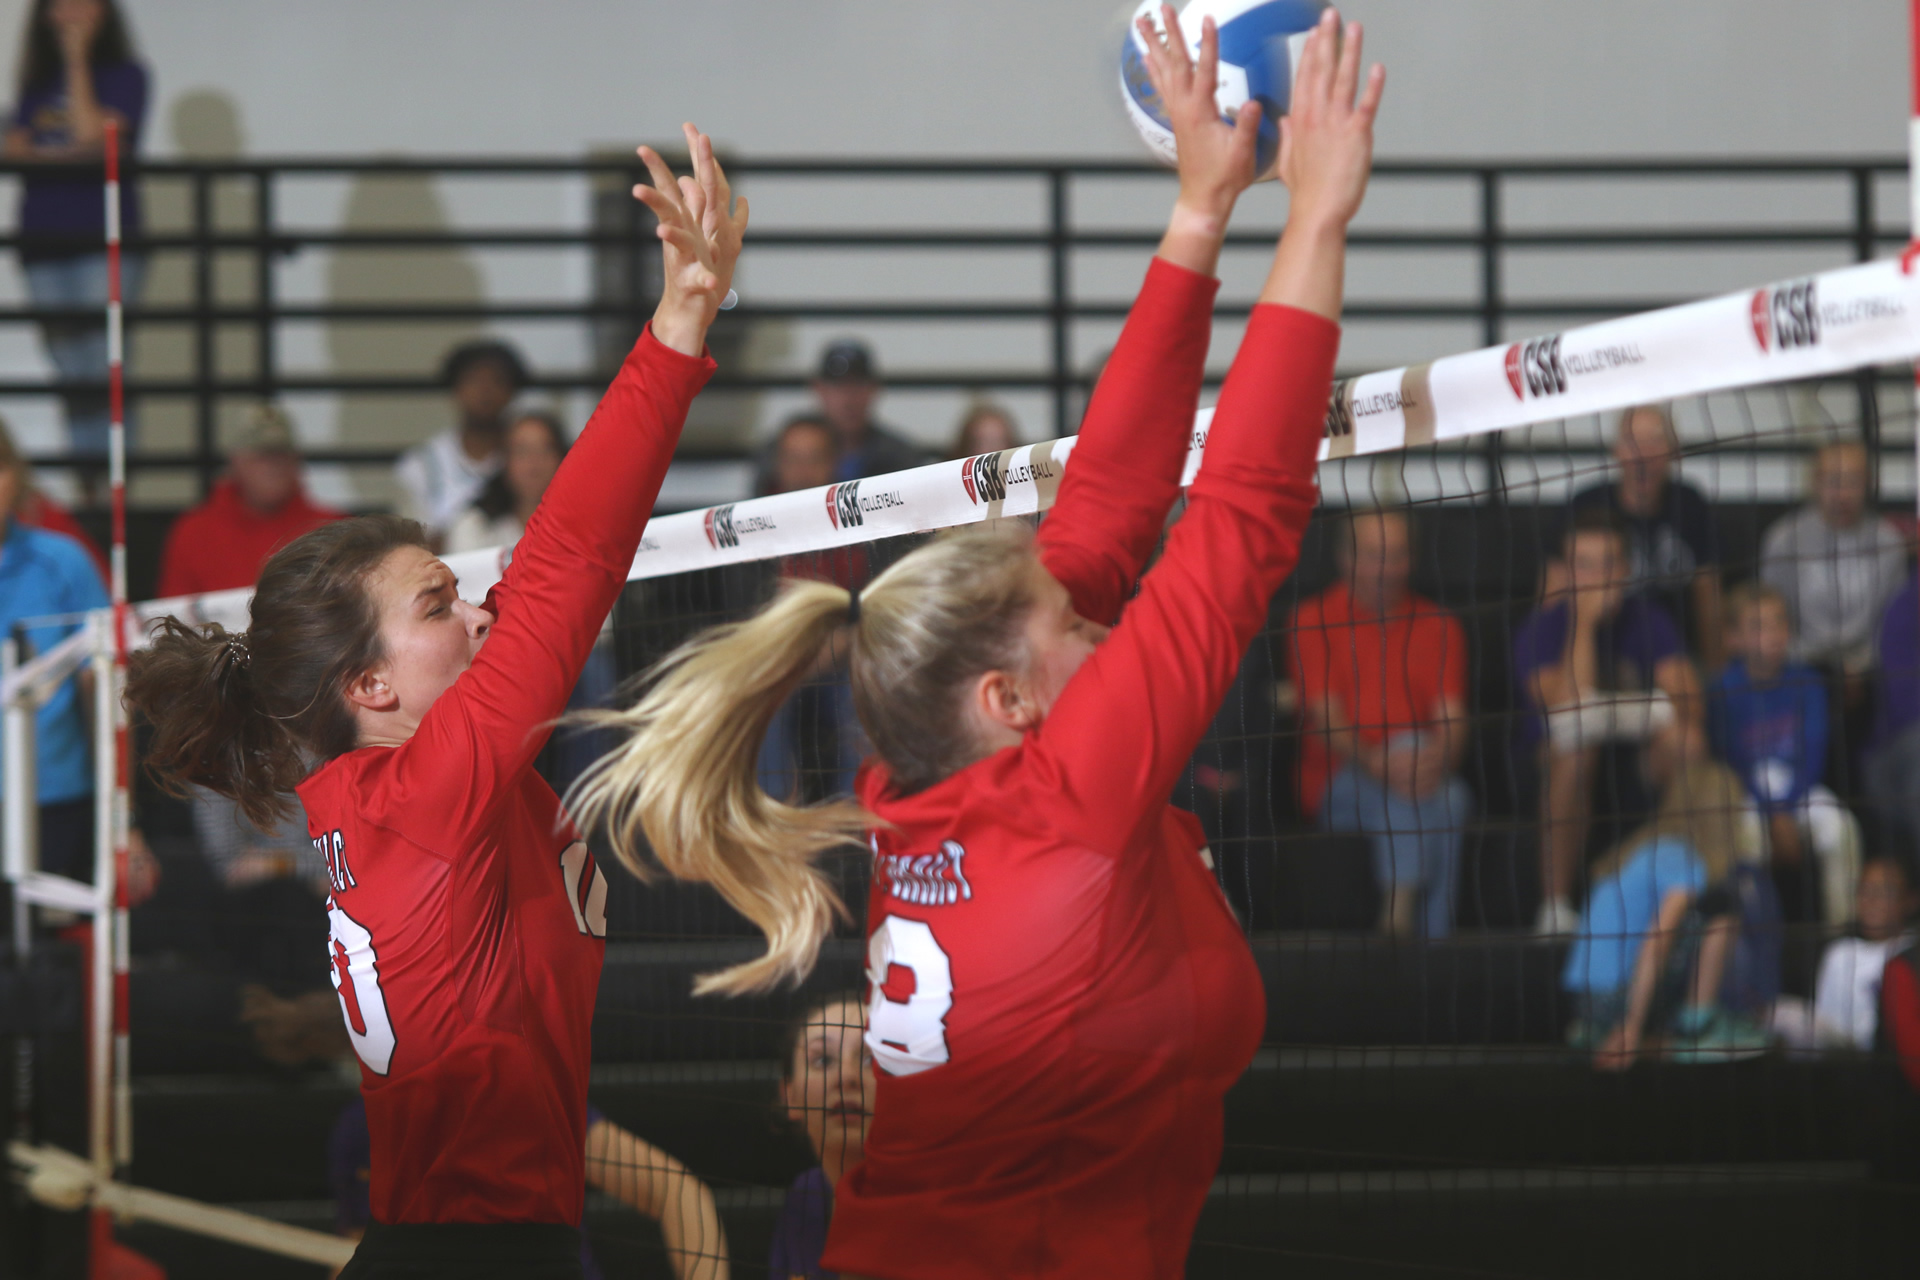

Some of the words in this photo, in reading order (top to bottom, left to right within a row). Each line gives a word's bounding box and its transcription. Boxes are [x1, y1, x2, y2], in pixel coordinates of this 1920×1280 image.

[1822, 297, 1906, 327] VOLLEYBALL
[1524, 335, 1567, 398] CSB
[1565, 343, 1646, 375] VOLLEYBALL
[1347, 389, 1417, 417] VOLLEYBALL
[974, 452, 1006, 503] CSB
[999, 462, 1054, 485] VOLLEYBALL
[714, 504, 739, 548] CSB
[733, 515, 777, 534] VOLLEYBALL
[836, 481, 863, 528] CSB
[859, 490, 904, 512] VOLLEYBALL
